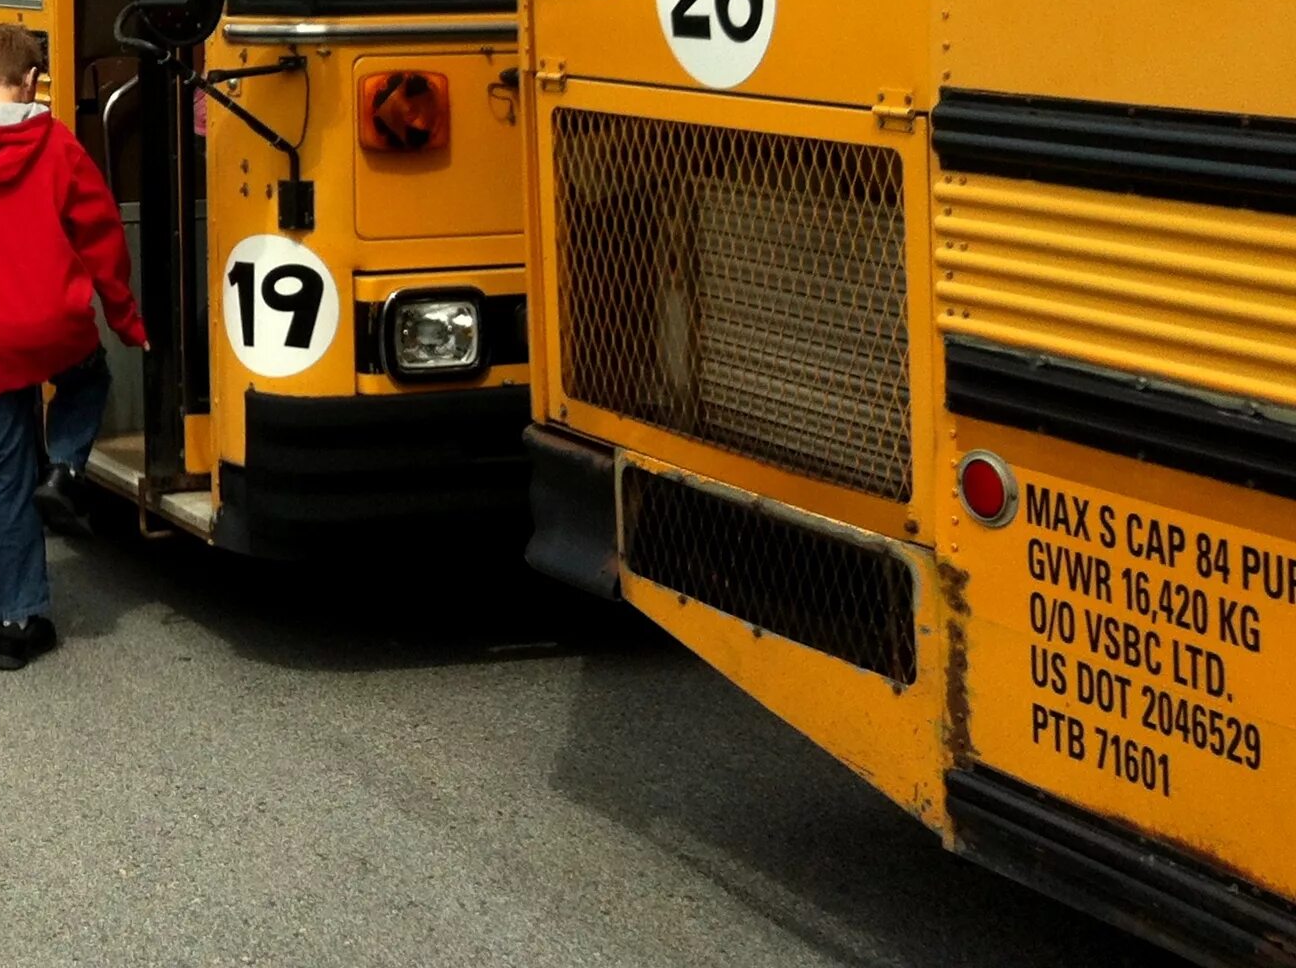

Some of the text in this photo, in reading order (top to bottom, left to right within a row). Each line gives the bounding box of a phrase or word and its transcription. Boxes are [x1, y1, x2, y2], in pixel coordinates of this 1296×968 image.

[227, 261, 324, 349] 19
[1026, 484, 1091, 541] MAX
[1100, 505, 1116, 549] S
[1127, 513, 1186, 567] CAP
[1197, 533, 1231, 584] 84
[1028, 538, 1261, 652] GVWR 16,420 KG
[1030, 592, 1233, 702] O/O VSBC LTD.
[1031, 645, 1261, 770] US DOT 2046529
[1032, 703, 1170, 797] PTB 71601
